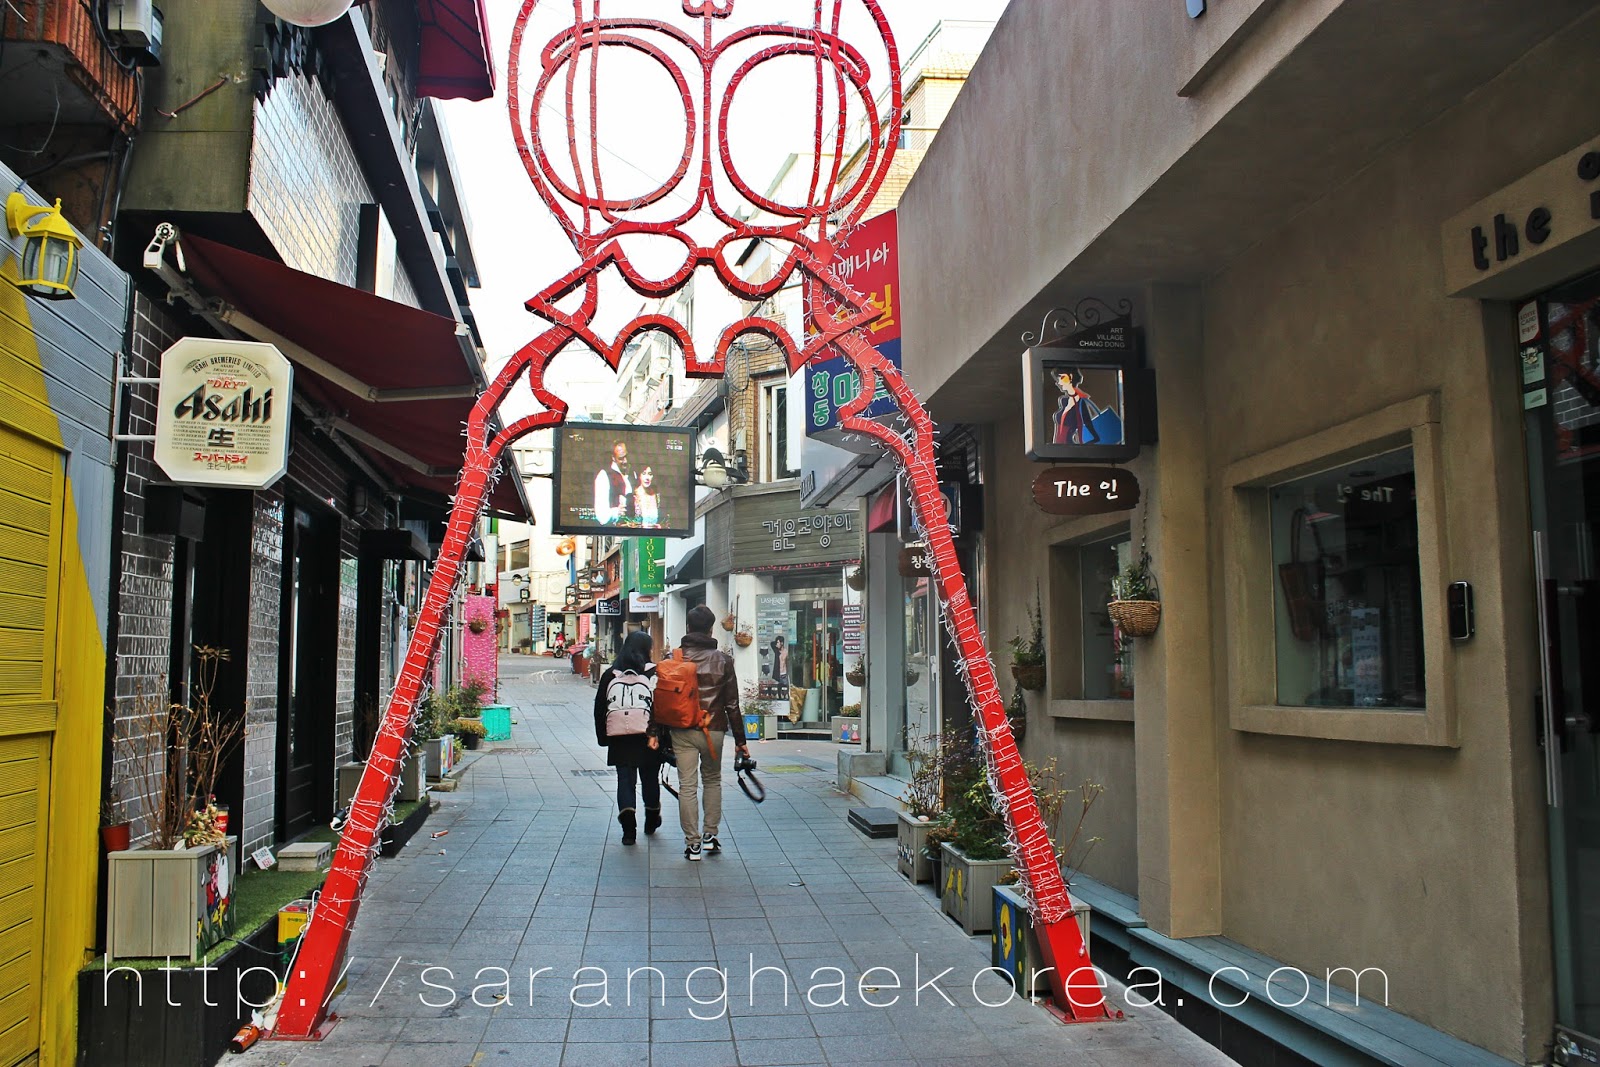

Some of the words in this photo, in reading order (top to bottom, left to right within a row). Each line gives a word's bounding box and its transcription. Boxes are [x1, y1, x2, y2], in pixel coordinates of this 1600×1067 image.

[1471, 207, 1552, 271] the
[826, 242, 890, 281] 매니아
[1079, 340, 1104, 348] CHANG
[1104, 341, 1126, 349] DONG
[192, 361, 209, 374] ASAHI
[210, 356, 242, 366] BREWERIES
[243, 361, 262, 379] LIMITED
[174, 383, 274, 424] Asahi
[207, 427, 235, 448] 生
[193, 452, 248, 464] スーパードライ
[1053, 480, 1091, 498] The
[1099, 479, 1119, 500] 인
[762, 513, 852, 551] 검은고양이
